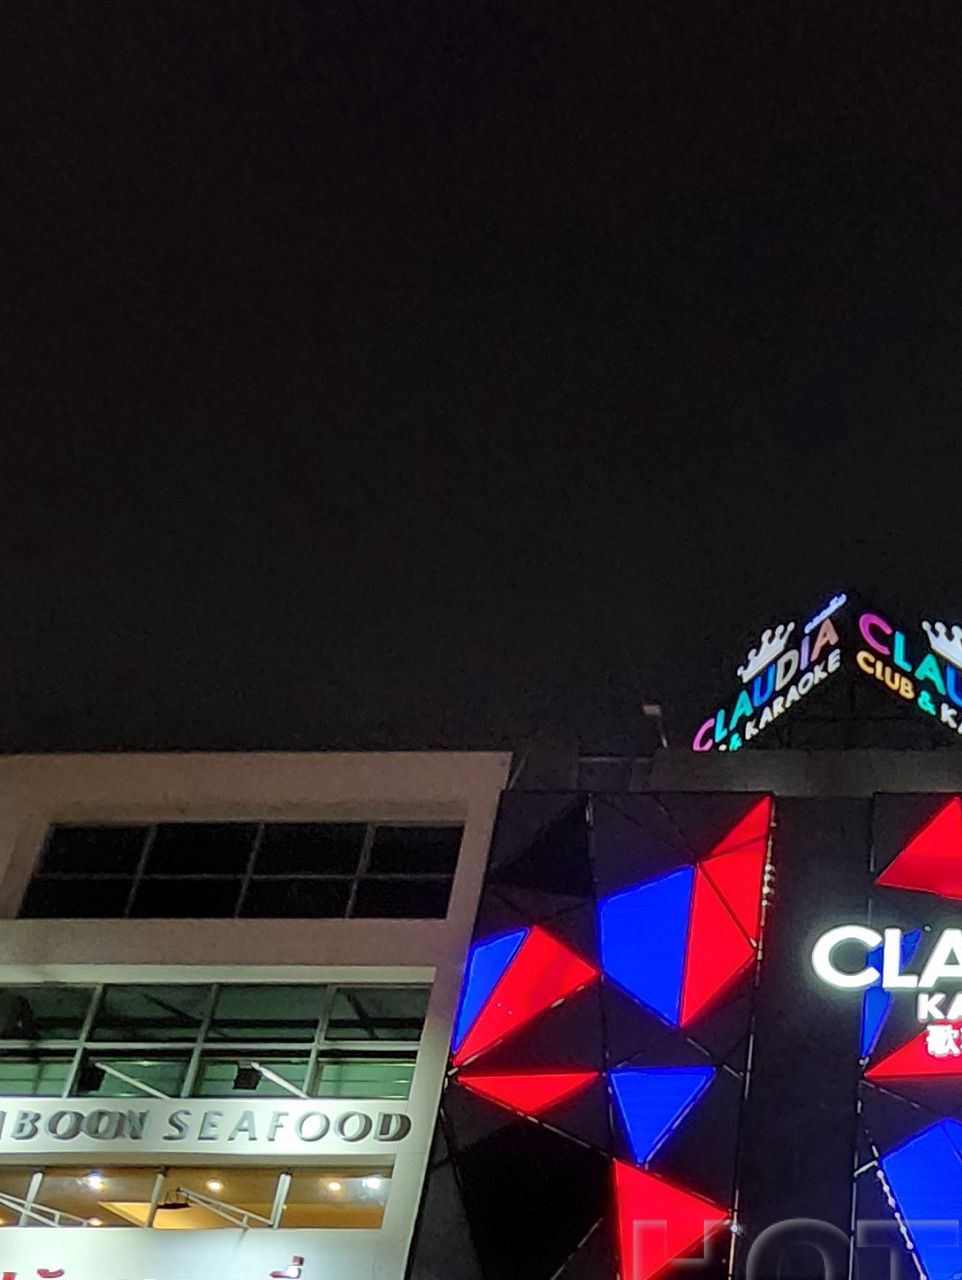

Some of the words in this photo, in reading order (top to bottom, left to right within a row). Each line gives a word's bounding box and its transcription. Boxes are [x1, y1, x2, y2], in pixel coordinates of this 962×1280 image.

[692, 618, 839, 752] CLAUDIA
[745, 648, 841, 740] KARAOKE
[856, 650, 915, 699] CLUB
[917, 690, 937, 716] &
[0, 1109, 149, 1141] BOON
[162, 1109, 412, 1142] SEAFOOD
